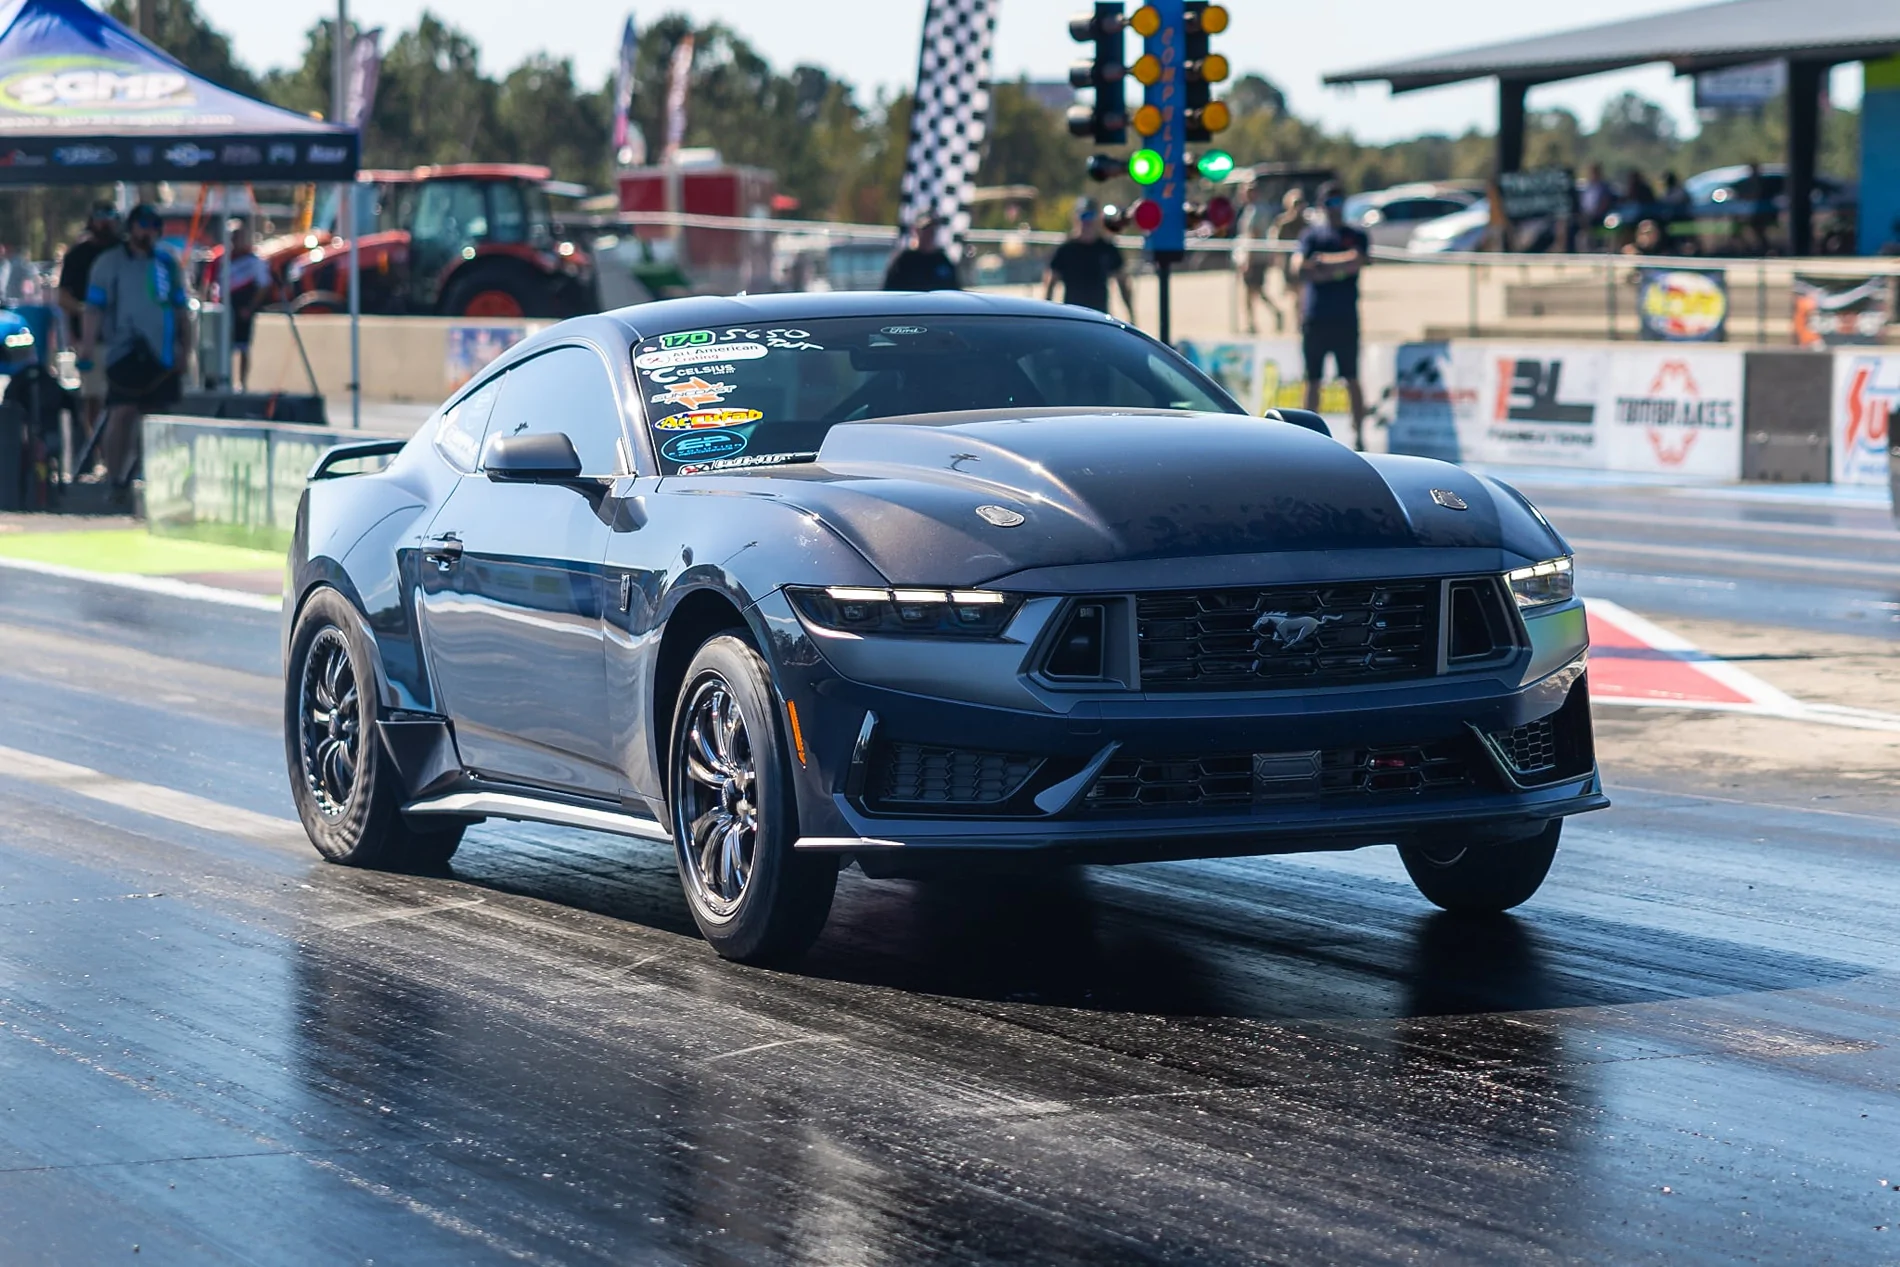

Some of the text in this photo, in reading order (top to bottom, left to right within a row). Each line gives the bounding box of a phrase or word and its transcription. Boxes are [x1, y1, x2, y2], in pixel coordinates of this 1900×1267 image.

[19, 71, 186, 106] SGMP
[1161, 27, 1176, 198] COMPULINK
[664, 332, 709, 347] 170
[695, 344, 759, 354] American
[674, 354, 719, 363] Crating
[654, 386, 733, 401] SUNCOAST
